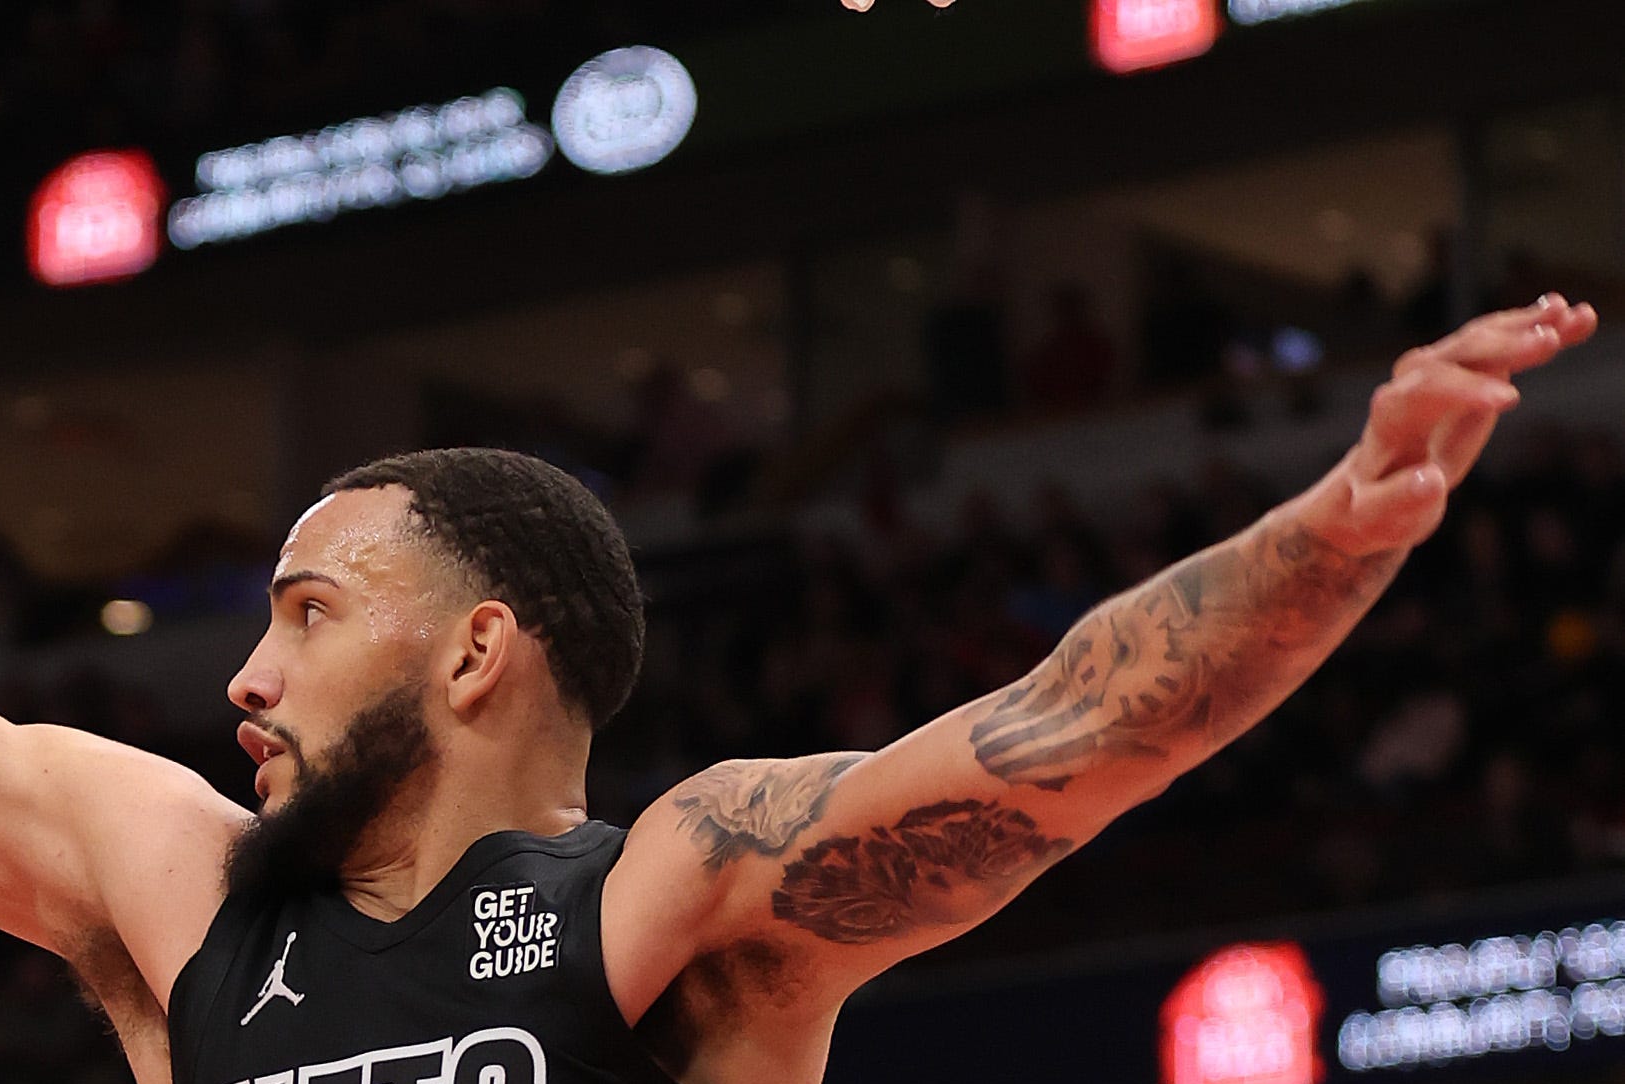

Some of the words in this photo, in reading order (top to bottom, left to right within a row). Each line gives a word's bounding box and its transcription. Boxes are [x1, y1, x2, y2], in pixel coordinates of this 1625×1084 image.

[474, 886, 534, 920] GET
[473, 912, 558, 949] YOUR
[469, 939, 556, 980] GUIDE
